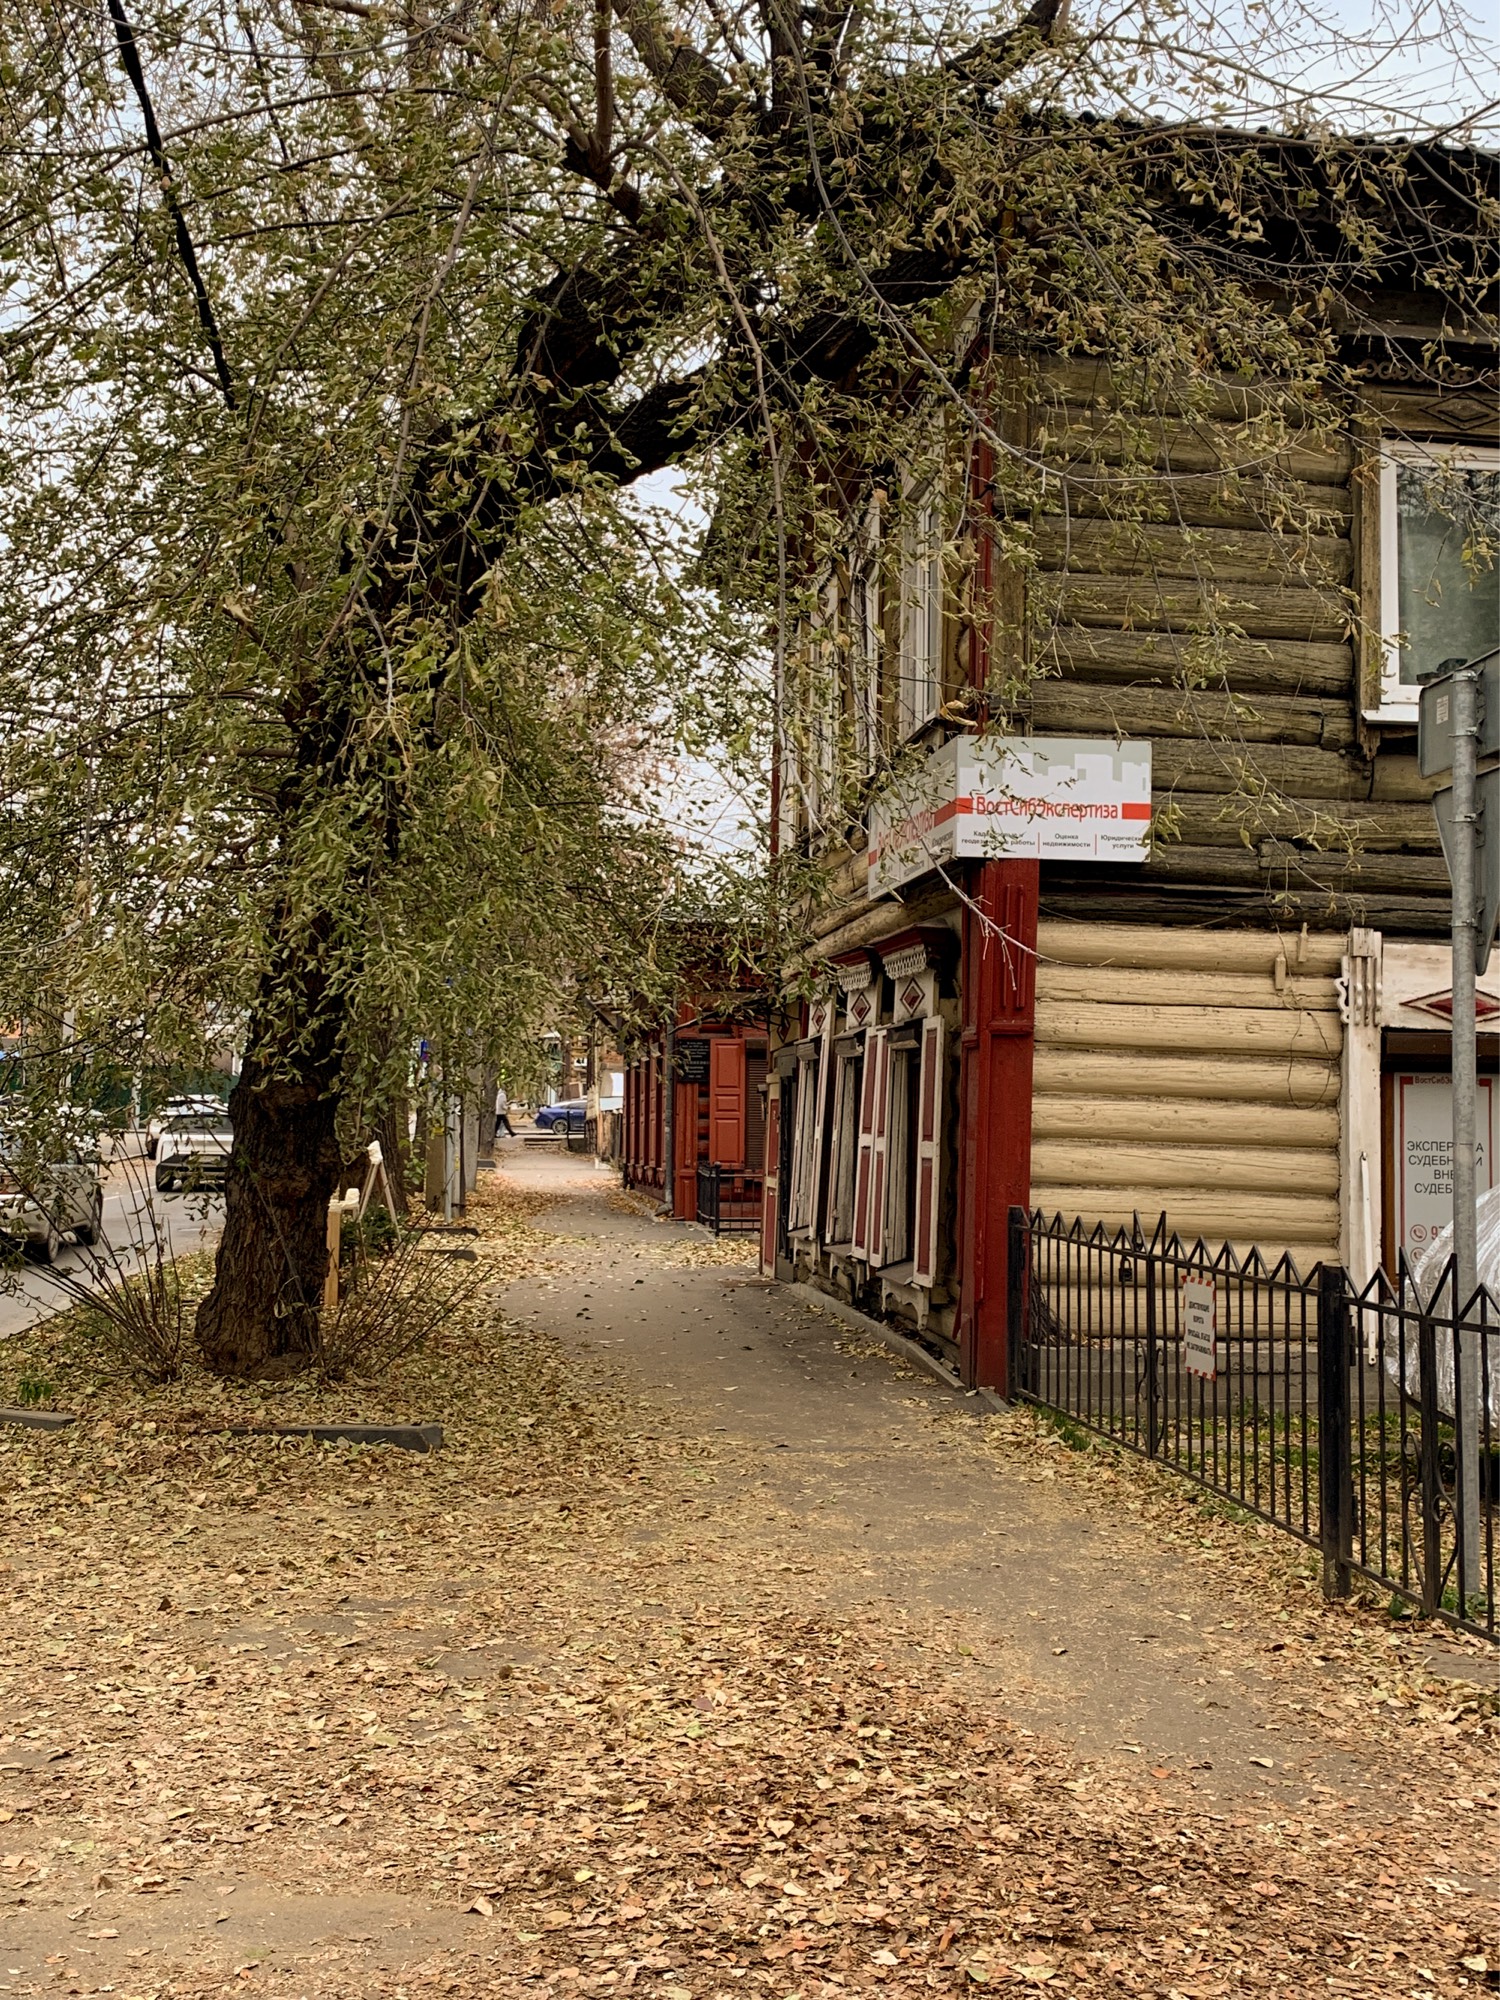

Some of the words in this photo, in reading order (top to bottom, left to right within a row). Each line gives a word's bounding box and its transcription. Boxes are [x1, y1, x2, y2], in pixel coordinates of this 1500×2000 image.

[1055, 833, 1079, 841] Оценка
[1112, 842, 1134, 850] услуги
[1406, 1140, 1484, 1152] ЭКСПЕРА
[1408, 1155, 1454, 1167] СУДЕБН
